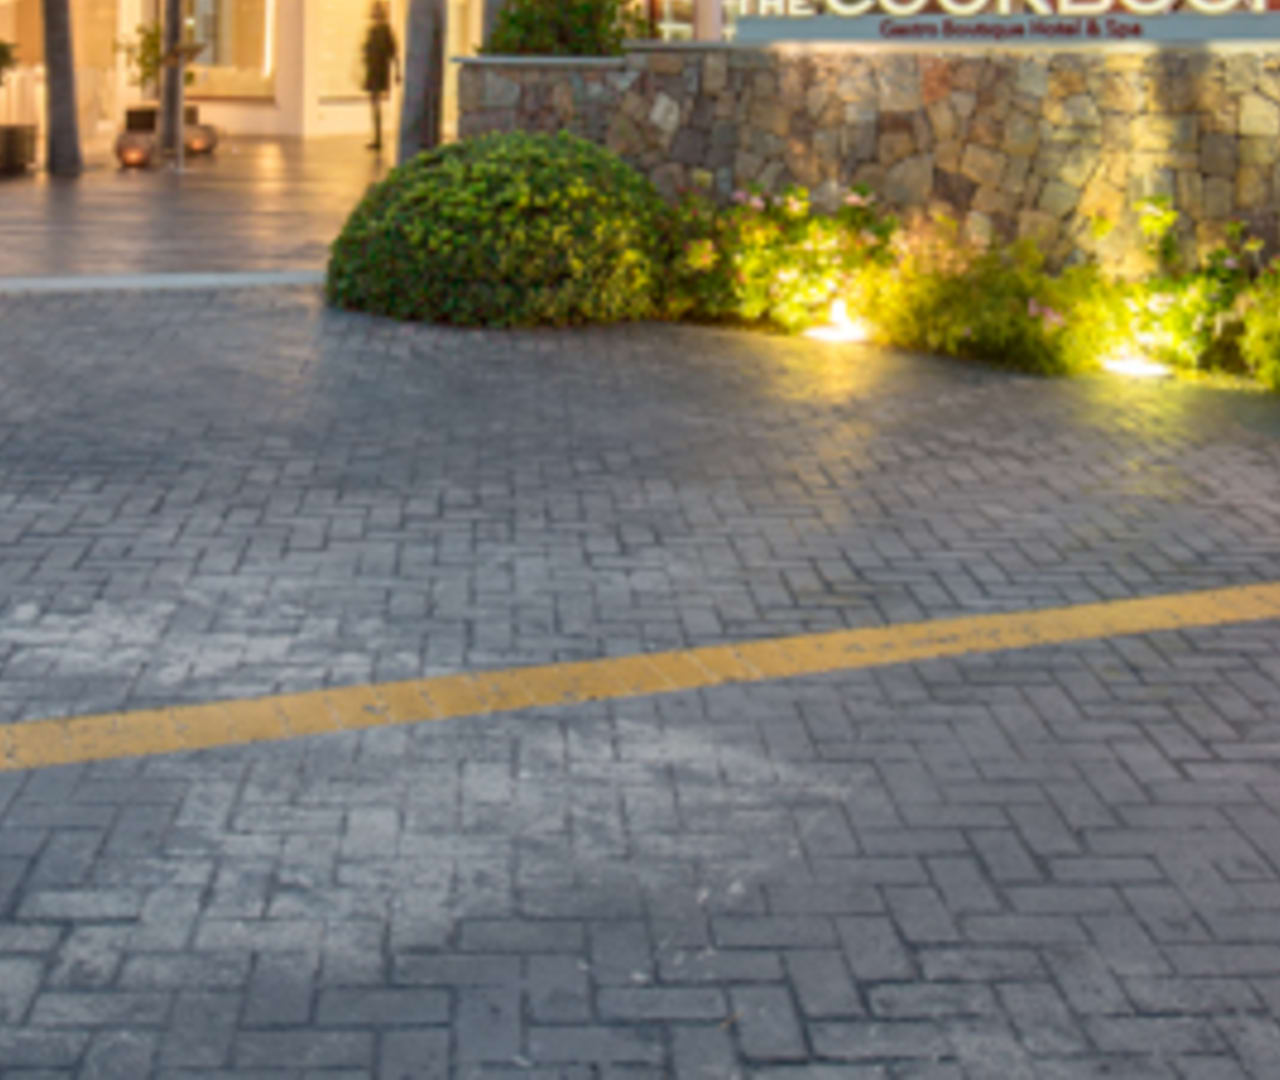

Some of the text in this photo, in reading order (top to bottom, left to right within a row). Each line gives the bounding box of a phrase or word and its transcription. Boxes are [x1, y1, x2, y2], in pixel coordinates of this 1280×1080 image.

[942, 18, 1025, 39] Boutique
[1029, 18, 1082, 36] Hotel
[1086, 18, 1101, 36] &
[1105, 18, 1143, 38] Spa
